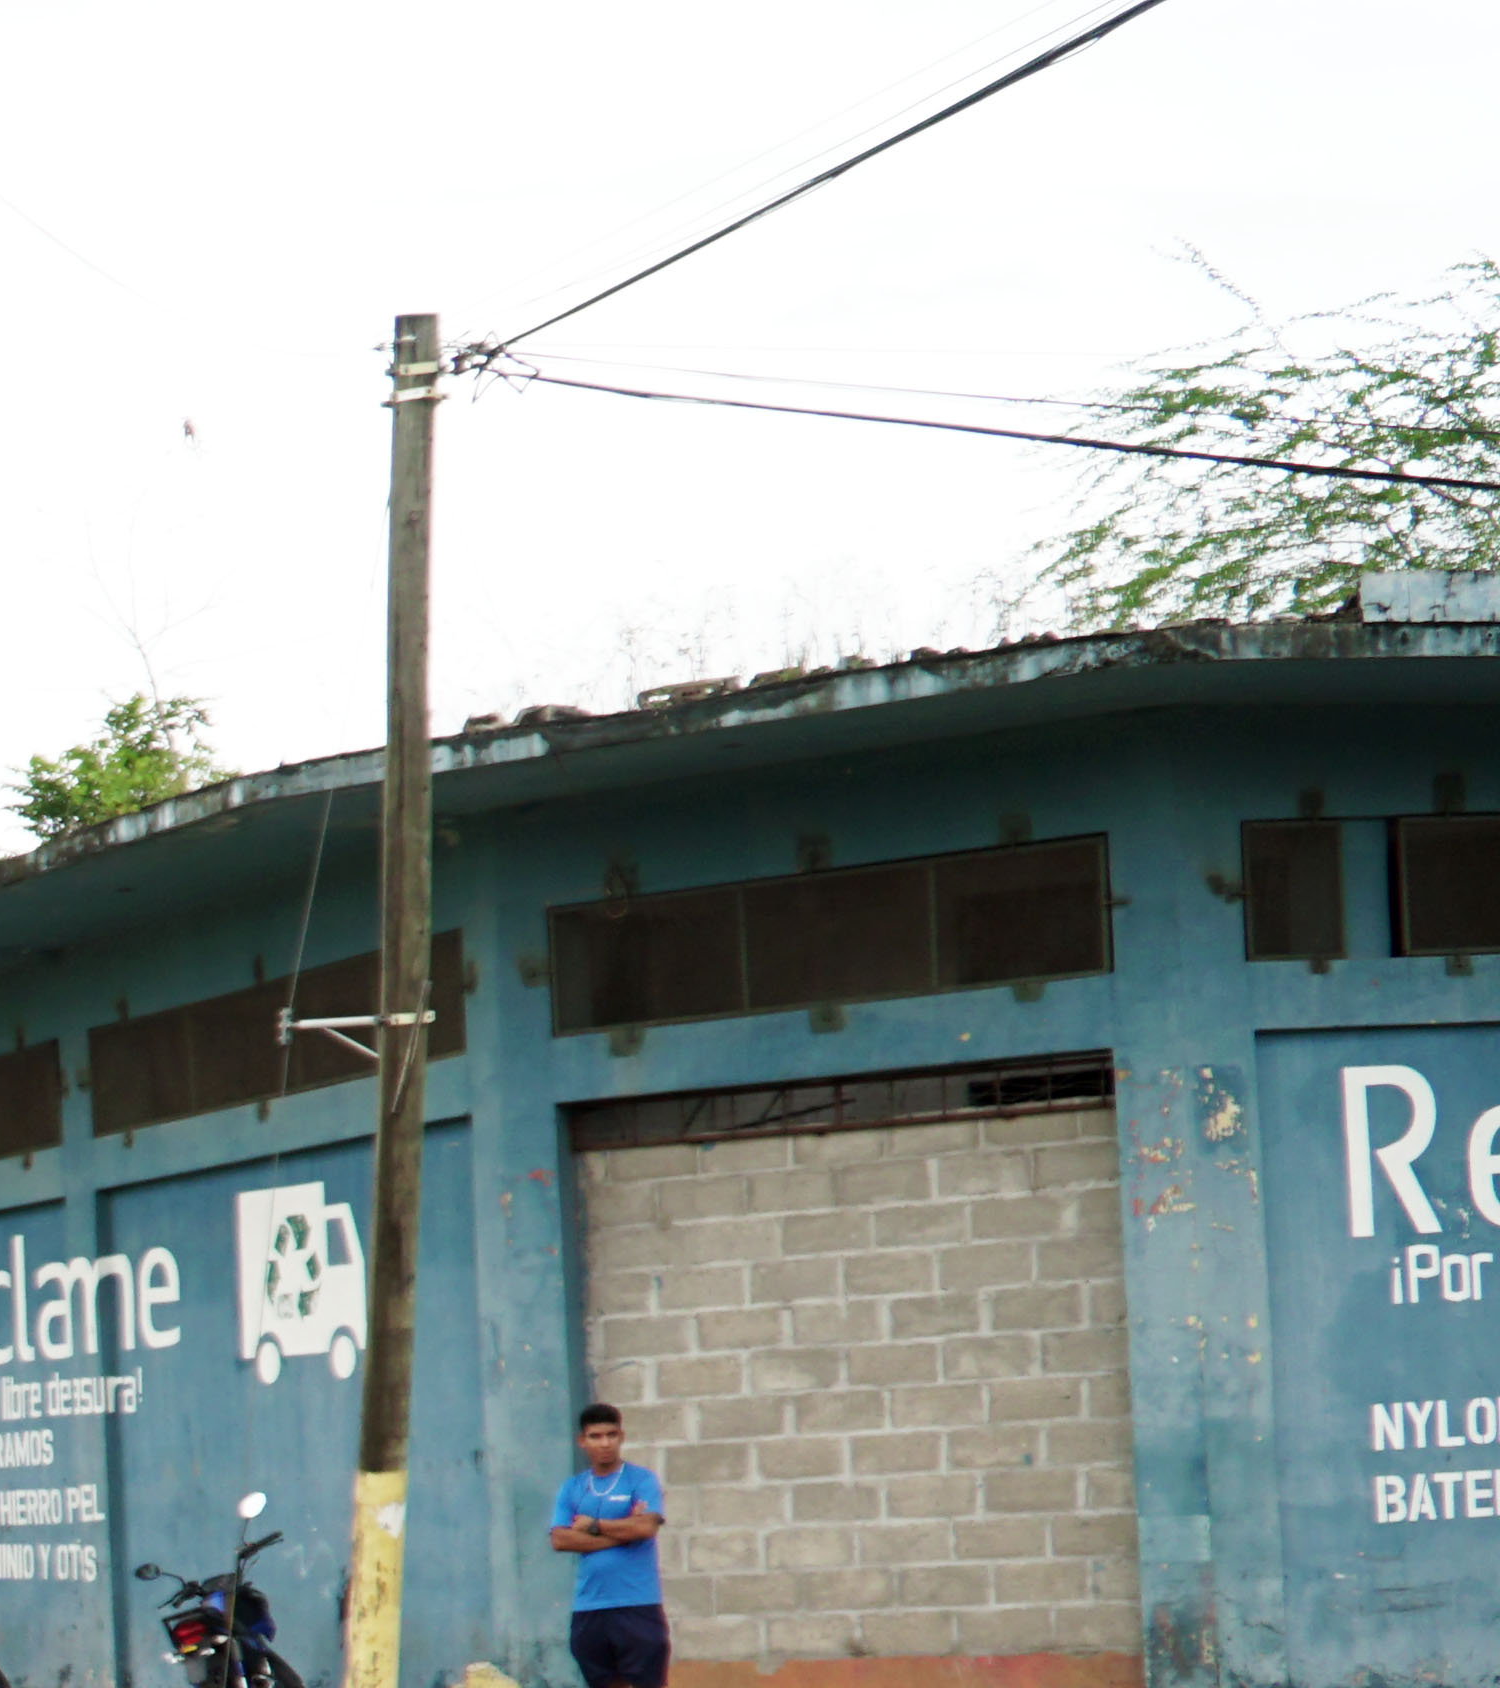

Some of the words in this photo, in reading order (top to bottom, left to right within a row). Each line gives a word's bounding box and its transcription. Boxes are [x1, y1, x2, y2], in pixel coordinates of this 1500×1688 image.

[0, 1376, 42, 1421] libre
[1371, 1397, 1500, 1451] NYLO
[1373, 1469, 1500, 1524] BATE
[38, 1544, 51, 1579] Y
